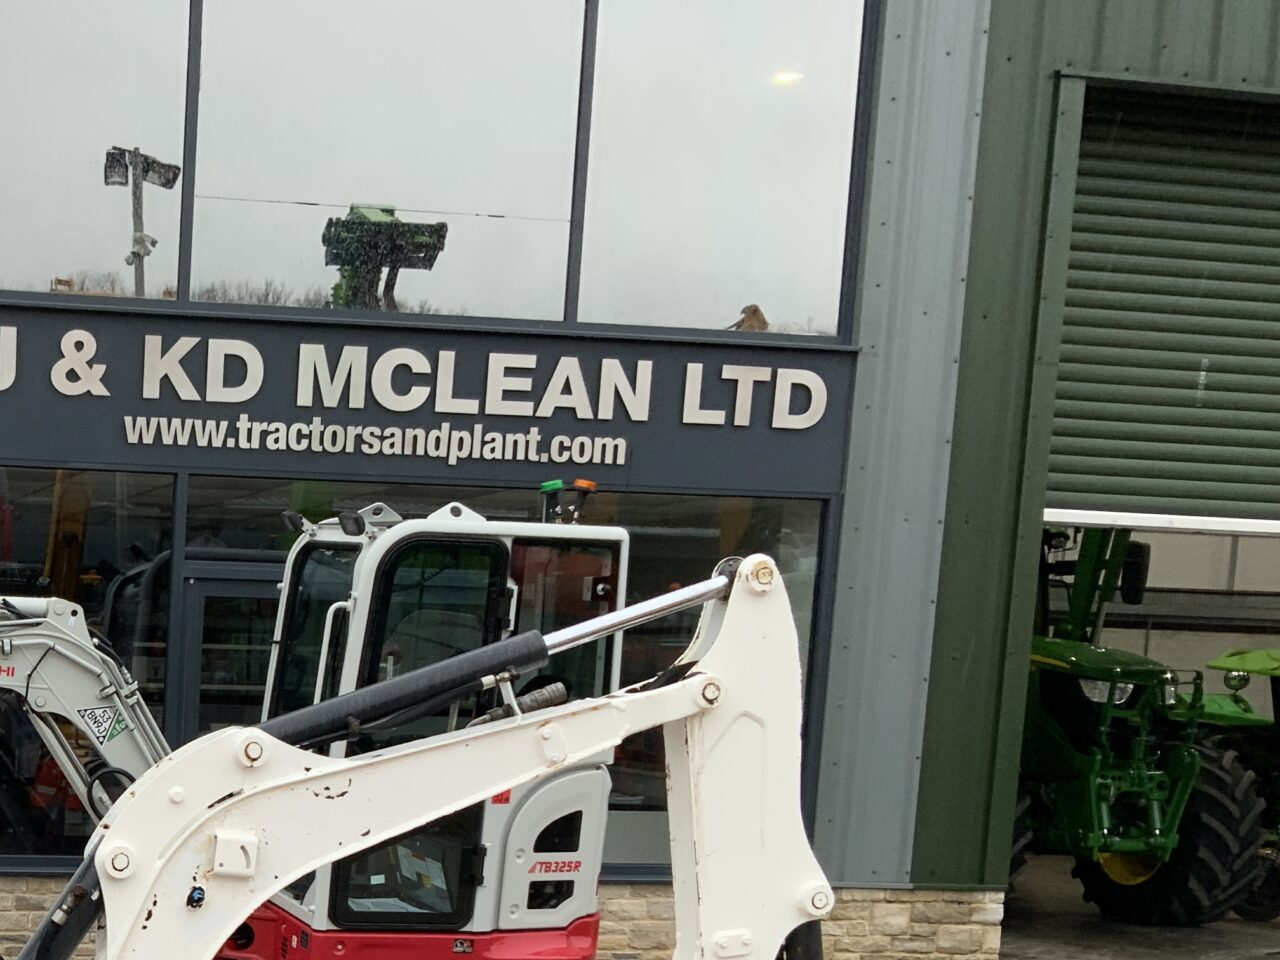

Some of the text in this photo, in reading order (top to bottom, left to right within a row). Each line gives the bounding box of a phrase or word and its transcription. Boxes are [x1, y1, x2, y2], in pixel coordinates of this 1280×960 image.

[50, 329, 111, 396] &
[142, 334, 265, 403] KD
[296, 343, 653, 422] MCLEAN
[682, 362, 828, 430] LTD
[123, 413, 627, 466] www.tractorsandplant.com
[99, 709, 111, 723] 53
[537, 861, 582, 874] TB325R
